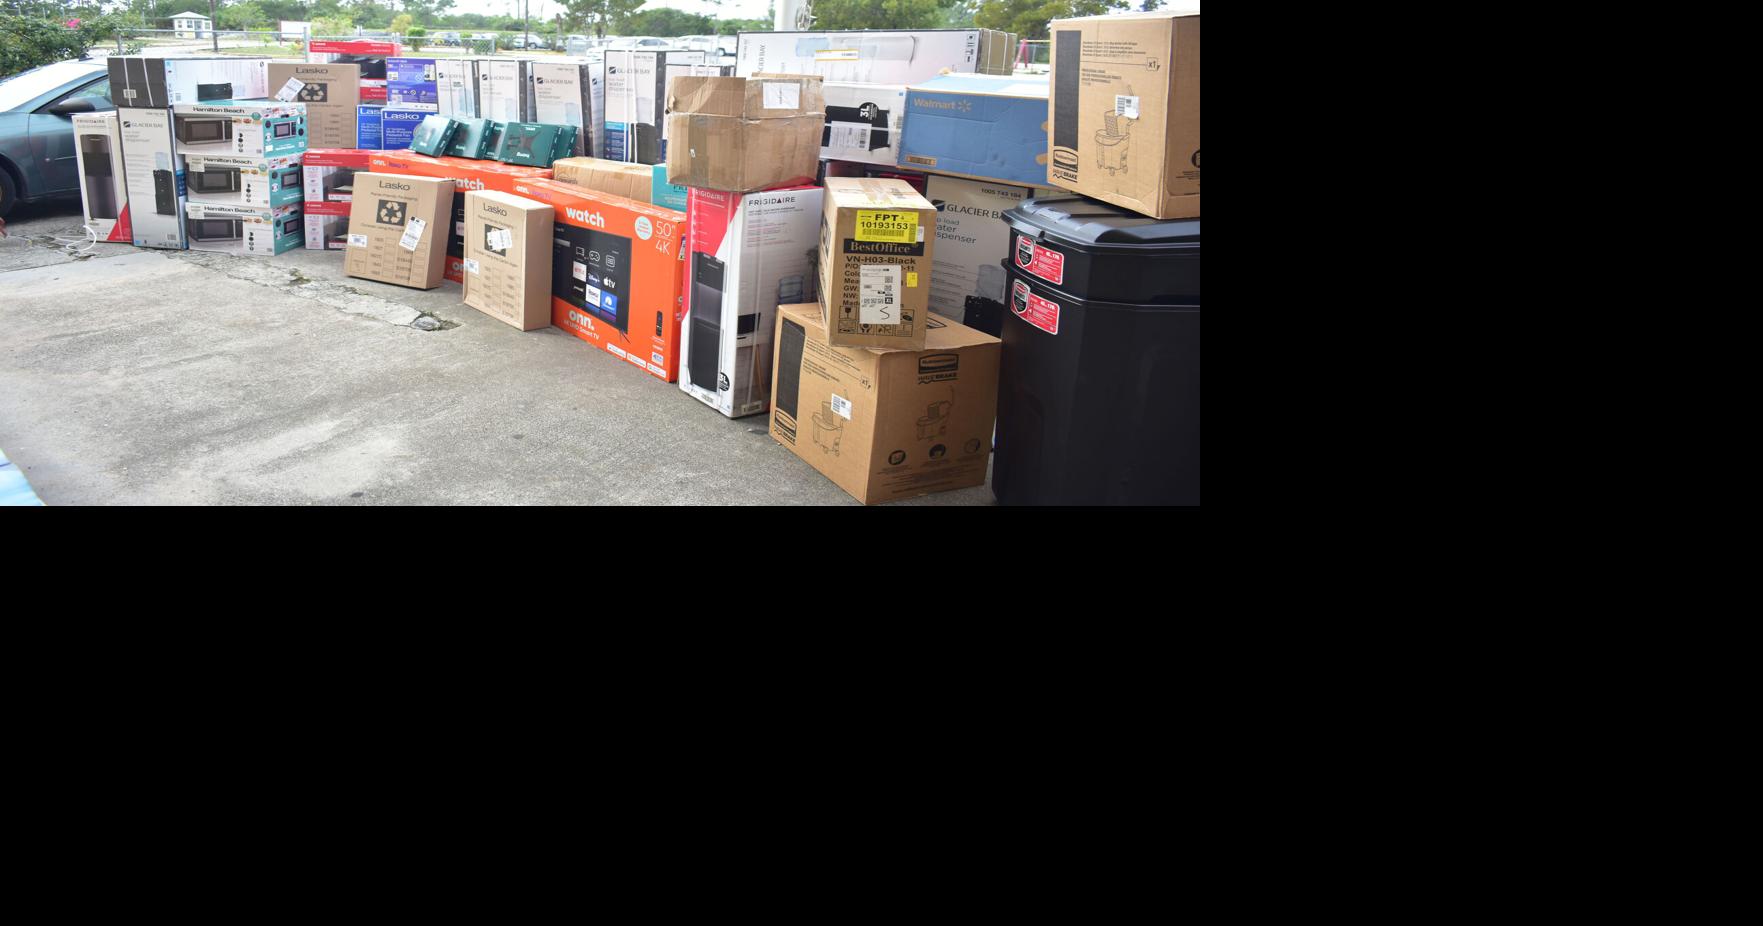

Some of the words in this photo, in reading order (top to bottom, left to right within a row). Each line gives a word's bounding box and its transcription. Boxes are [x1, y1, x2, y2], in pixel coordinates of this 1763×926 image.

[913, 97, 956, 111] Walmart
[360, 107, 382, 116] Las
[384, 112, 420, 121] Lasko
[859, 105, 871, 119] 3L
[379, 180, 411, 191] Lasko
[748, 196, 796, 206] FRIGIDAIRE
[483, 202, 507, 217] Lasko
[946, 204, 990, 218] GLACIER
[565, 206, 605, 228] watch
[875, 213, 900, 221] FPT
[943, 218, 960, 226] load
[860, 221, 909, 230] 10193153
[936, 223, 957, 233] ater
[655, 239, 670, 256] 4K
[850, 242, 910, 254] BestOffice
[845, 255, 917, 265] VN-H03-Black
[569, 309, 595, 331] onn.
